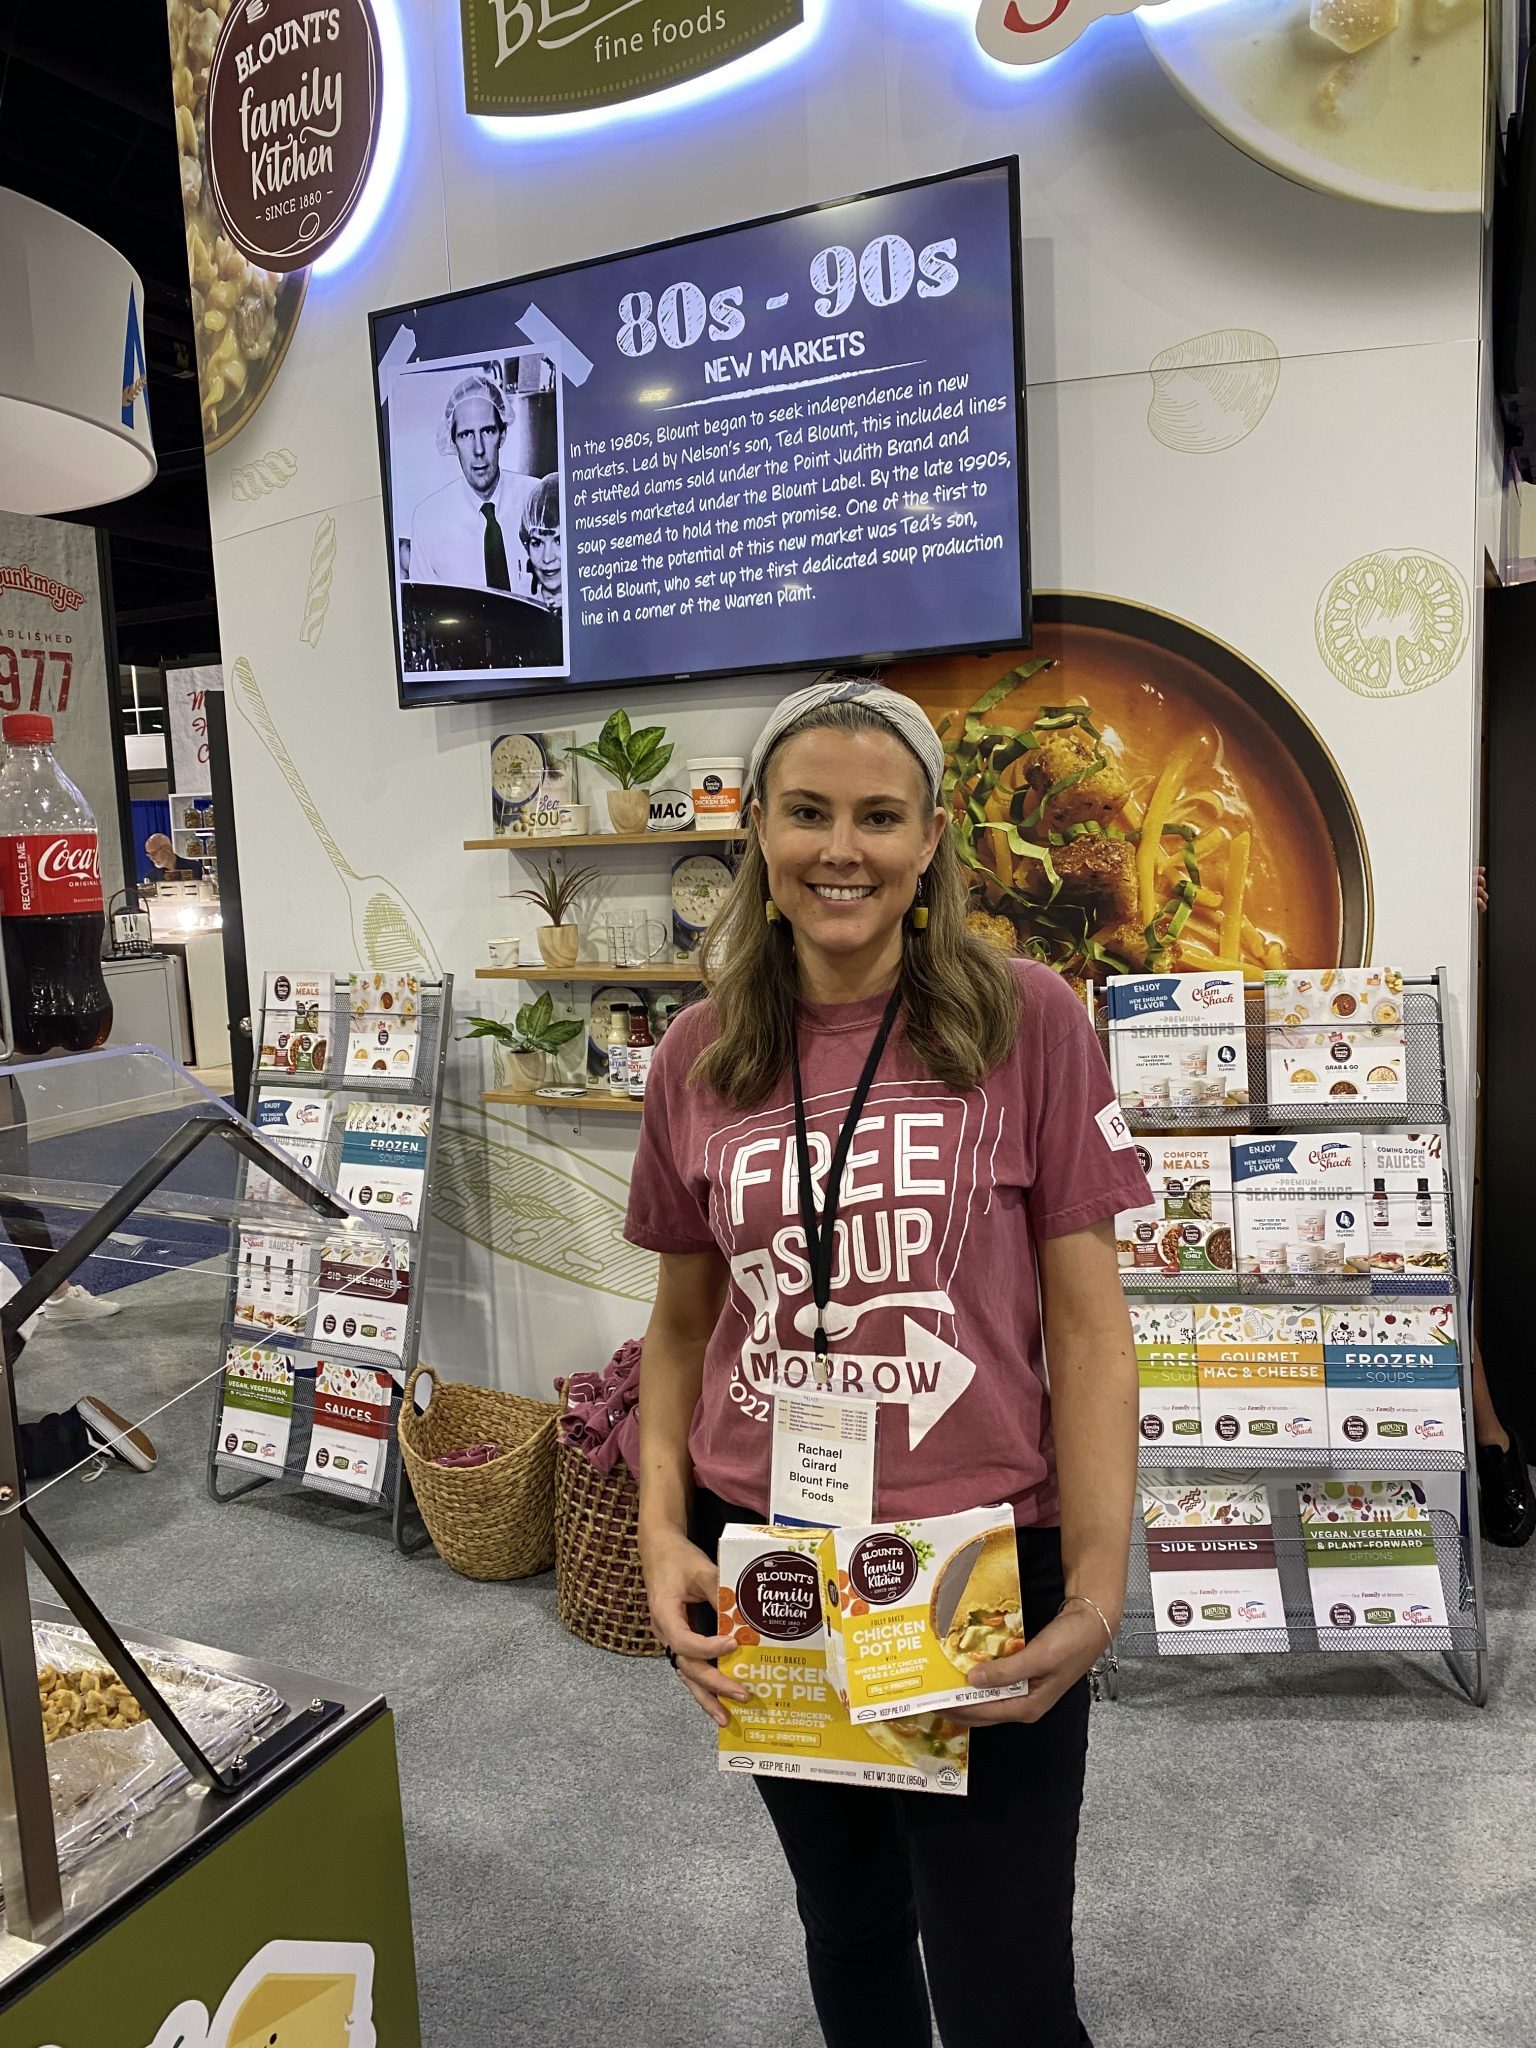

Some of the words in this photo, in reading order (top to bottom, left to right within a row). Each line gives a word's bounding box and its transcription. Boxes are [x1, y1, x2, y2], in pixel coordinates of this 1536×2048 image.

[594, 32, 644, 63] fine
[652, 5, 727, 46] foods
[235, 8, 340, 84] BLOUNT'S
[239, 66, 343, 152] family
[251, 133, 333, 200] Kitchen
[265, 198, 296, 221] SINCE
[299, 190, 322, 210] 1880
[616, 281, 746, 357] 80s
[766, 292, 789, 310] -
[810, 234, 959, 318] 90s
[704, 352, 753, 384] NEW
[761, 331, 867, 372] MARKETS
[570, 443, 581, 458] In
[583, 439, 606, 455] the
[610, 431, 652, 451] 1980s,
[656, 420, 700, 443] Blount
[704, 414, 746, 436] began
[749, 410, 764, 425] to
[768, 402, 804, 422] seek
[807, 385, 913, 415] independence
[918, 379, 932, 396] in
[937, 373, 968, 392] new
[572, 460, 628, 482] markets.
[632, 452, 658, 472] Led
[662, 451, 677, 470] by
[681, 440, 740, 464] Nelson's
[744, 437, 772, 453] son,
[774, 427, 803, 447] Ted
[808, 419, 858, 442] Blount,
[861, 413, 891, 432] this
[896, 398, 963, 427] included
[969, 395, 1006, 415] lines
[573, 489, 587, 506] of
[591, 480, 639, 503] stuffed
[644, 477, 682, 495] clams
[686, 468, 715, 488] sold
[719, 462, 761, 482] under
[763, 459, 788, 475] the
[793, 449, 831, 471] Point
[833, 442, 882, 465] Judith
[887, 431, 933, 456] Brand
[938, 425, 969, 448] and
[575, 509, 627, 530] mussels
[630, 496, 695, 522] marketed
[698, 492, 740, 511] under
[742, 488, 767, 504] the
[771, 478, 818, 501] Blount
[822, 471, 865, 493] Label.
[870, 468, 889, 488] By
[891, 464, 919, 481] the
[924, 458, 953, 477] late
[958, 450, 1010, 472] 1990s,
[577, 538, 606, 555] soup
[610, 527, 662, 549] seemed
[664, 526, 678, 541] to
[682, 519, 711, 539] hold
[714, 518, 738, 534] the
[743, 510, 778, 530] most
[781, 503, 841, 529] promise.
[846, 498, 877, 515] One
[882, 491, 898, 510] of
[902, 491, 930, 510] the
[932, 483, 968, 505] first
[970, 480, 987, 496] to
[578, 557, 638, 579] recognize
[640, 554, 663, 569] the
[667, 543, 724, 570] potential
[728, 540, 743, 558] of
[746, 537, 774, 555] this
[778, 534, 806, 551] new
[811, 524, 863, 547] market
[867, 522, 897, 539] was
[899, 513, 942, 534] Ted's
[946, 511, 977, 528] son,
[579, 582, 612, 601] Todd
[616, 578, 660, 598] Blount,
[663, 575, 690, 592] who
[694, 570, 716, 588] set
[719, 570, 736, 587] up
[738, 566, 763, 582] the
[766, 559, 798, 579] first
[802, 548, 877, 574] dedicated
[882, 546, 918, 565] soup
[922, 533, 1003, 562] production
[0, 564, 84, 612] unkmeyer
[581, 610, 603, 625] line
[607, 607, 618, 623] in
[622, 609, 631, 621] a
[634, 602, 676, 620] corner
[679, 597, 694, 615] of
[696, 596, 720, 612] the
[724, 591, 772, 609] Warren
[777, 583, 816, 607] plant.
[650, 802, 687, 820] MAC
[16, 841, 27, 860] ME
[19, 861, 31, 911] RECYCLE
[69, 880, 99, 888] ORIGINAL
[1134, 983, 1160, 993] ENJOY
[1192, 987, 1220, 1001] Clam
[1134, 1001, 1165, 1011] FLAVOR
[1203, 994, 1234, 1009] Shack
[1109, 1116, 1125, 1138] B
[370, 1139, 419, 1153] FROZEN
[1163, 1151, 1209, 1159] COMFORT
[1249, 1144, 1276, 1154] ENJOY
[1163, 1160, 1210, 1170] MEALS
[1309, 1151, 1337, 1164] Clam
[1320, 1157, 1352, 1172] Shack
[1377, 1155, 1425, 1168] SAUCES
[731, 1113, 946, 1226] FREE
[1249, 1163, 1280, 1173] FLAVOR
[772, 1208, 933, 1296] SOUP
[1221, 1352, 1299, 1364] GOURMET
[1345, 1353, 1434, 1368] FROZEN
[1204, 1367, 1238, 1378] MAC
[1243, 1367, 1253, 1378] &
[1257, 1366, 1319, 1378] CHEESE
[1366, 1372, 1415, 1383] SOUPS
[324, 1402, 372, 1423] SAUCES
[798, 1443, 842, 1459] Rachael
[802, 1458, 837, 1473] Girard
[790, 1472, 823, 1486] Blount
[826, 1478, 849, 1490] Fine
[802, 1489, 834, 1503] Foods
[1310, 1530, 1351, 1539] VEGAN,
[1353, 1529, 1426, 1538] VEGETARIAN,
[861, 1547, 904, 1561] BLOUNT'S
[1161, 1541, 1196, 1552] SIDE
[1201, 1541, 1258, 1552] DISHES
[1328, 1540, 1423, 1550] PLANT-FORWARD
[863, 1559, 904, 1578] family
[756, 1571, 814, 1585] BLOUNT'S
[868, 1573, 901, 1589] Kitchen
[757, 1583, 814, 1610] family
[762, 1601, 807, 1620] Kitchen
[852, 1619, 926, 1644] CHICKEN
[860, 1640, 892, 1659] POT
[897, 1635, 922, 1652] PIE
[760, 1654, 781, 1664] FULLY
[784, 1655, 807, 1665] BAKED
[732, 1663, 829, 1684] CHICKEN
[792, 1684, 827, 1702] PIE
[741, 1715, 766, 1724] PEAS
[778, 1717, 825, 1728] CARROTS
[759, 1760, 774, 1770] KEEP
[775, 1762, 784, 1771] PIE
[785, 1763, 801, 1773] FLAT!
[863, 1770, 875, 1781] NET
[876, 1771, 886, 1782] WT
[887, 1773, 896, 1783] 30
[897, 1774, 906, 1784] OZ
[906, 1776, 928, 1787] (850g)
